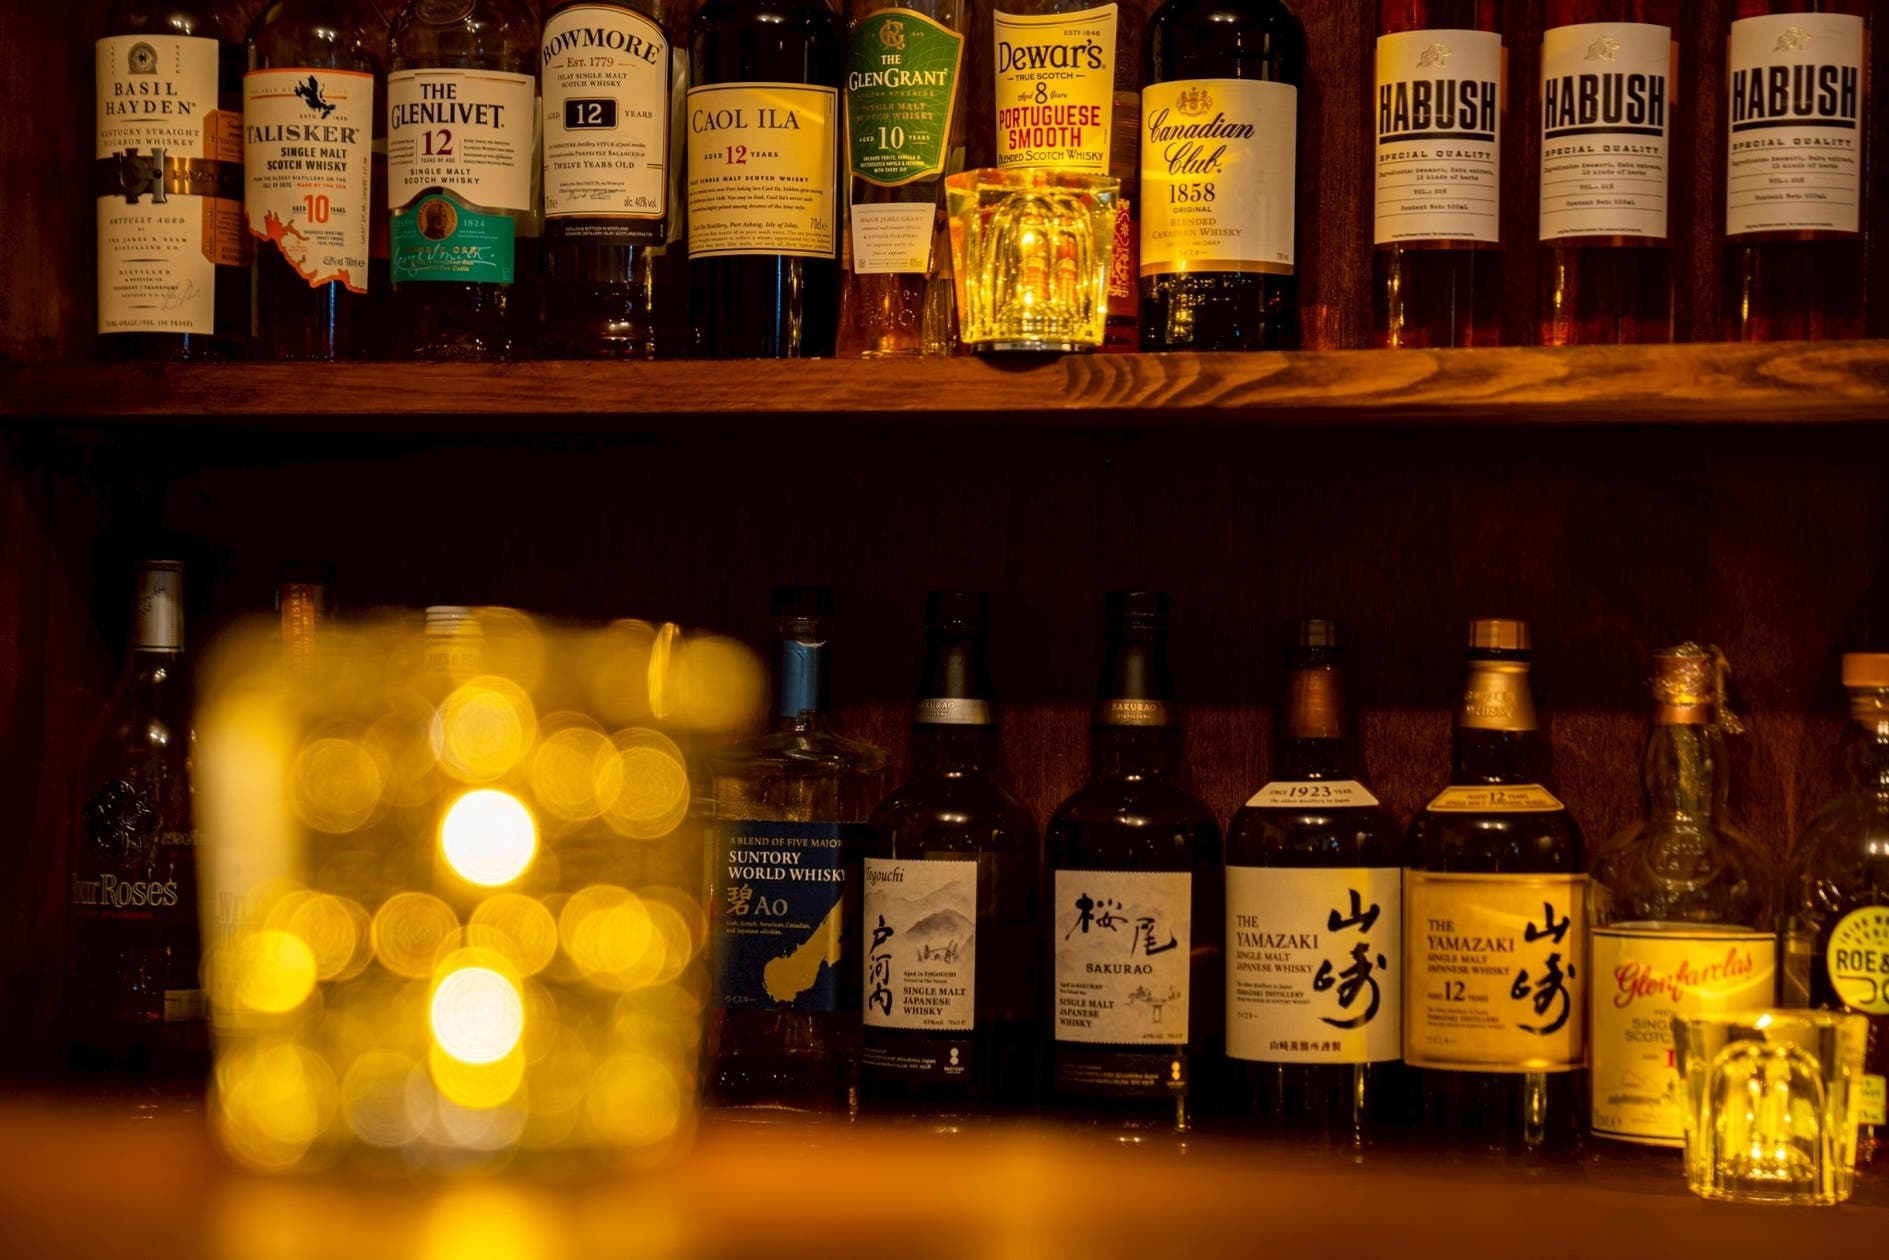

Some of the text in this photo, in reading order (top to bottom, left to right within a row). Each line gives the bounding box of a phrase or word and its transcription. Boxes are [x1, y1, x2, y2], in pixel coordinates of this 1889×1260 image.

[542, 28, 660, 66] BOWMORE
[590, 56, 615, 67] 1779
[880, 55, 902, 65] THE
[998, 39, 1103, 74] Dewar's
[114, 82, 178, 96] BASIL
[420, 83, 456, 99] THE
[1035, 82, 1048, 104] 8
[1733, 65, 1858, 122] HABUSH
[1380, 79, 1496, 135] HABUSH
[1545, 73, 1665, 130] HABUSH
[577, 103, 602, 124] 12
[624, 110, 653, 118] YEARS
[1000, 105, 1101, 130] PORTUGUESE
[692, 108, 800, 134] CAOL ILA
[1148, 108, 1255, 143] Canadian
[145, 128, 200, 137] STRAIGHT
[246, 124, 358, 144] TALISKER
[878, 126, 904, 149] 10
[1009, 127, 1081, 150] SMOOTH
[422, 129, 453, 156] 12
[1733, 138, 1851, 150] SPECIAL QUALITY
[281, 147, 347, 159] SINGLE MALT
[725, 145, 747, 165] 12
[1025, 150, 1064, 162] SCOTCH
[1066, 149, 1104, 161] WHISKY
[1379, 150, 1491, 162] SPECIAL QUALITY
[1545, 145, 1659, 157] SPECIAL QUALITY
[267, 160, 347, 172] SCOTCH WHISKY
[583, 160, 612, 168] YEARS
[615, 160, 635, 168] OLD
[404, 177, 437, 185] SCOTCH
[1170, 183, 1216, 203] 1858
[304, 194, 329, 224] 10
[463, 219, 485, 227] 1824
[1200, 228, 1242, 237] WHISKY
[1111, 703, 1157, 711] SAKURAO
[1289, 786, 1332, 798] 1923
[1490, 792, 1505, 804] 12
[737, 837, 769, 846] BLEND
[771, 838, 785, 847] OF
[787, 838, 808, 847] FIVE
[728, 851, 801, 865] SUNTORY
[728, 867, 786, 880] WORLD
[726, 883, 753, 916] 碧
[1065, 892, 1178, 959] 桜尾
[1236, 915, 1259, 928] THE
[1427, 920, 1455, 932] THE
[1236, 932, 1318, 949] YAMAZAKI
[1427, 936, 1515, 952] YAMAZAKI
[1236, 952, 1291, 961] SINGLE MALT
[1427, 954, 1488, 964] SINGLE MALT
[1086, 963, 1153, 975] SAKURAO
[1236, 963, 1314, 974] JAPANESE WHISKY
[1427, 965, 1510, 975] JAPANESE WHISKY
[1613, 947, 1753, 1008] Glenfarclas
[903, 987, 967, 996] SINGLE MALT
[1444, 981, 1466, 1002] 12
[903, 996, 951, 1005] JAPANESE
[1060, 998, 1114, 1009] SINGLE MALT
[903, 1006, 943, 1015] WHISKY
[1060, 1008, 1099, 1018] JAPANESE
[1060, 1018, 1092, 1028] WHISKY
[1632, 1019, 1669, 1031] SING
[1625, 1030, 1672, 1043] SCOTC
